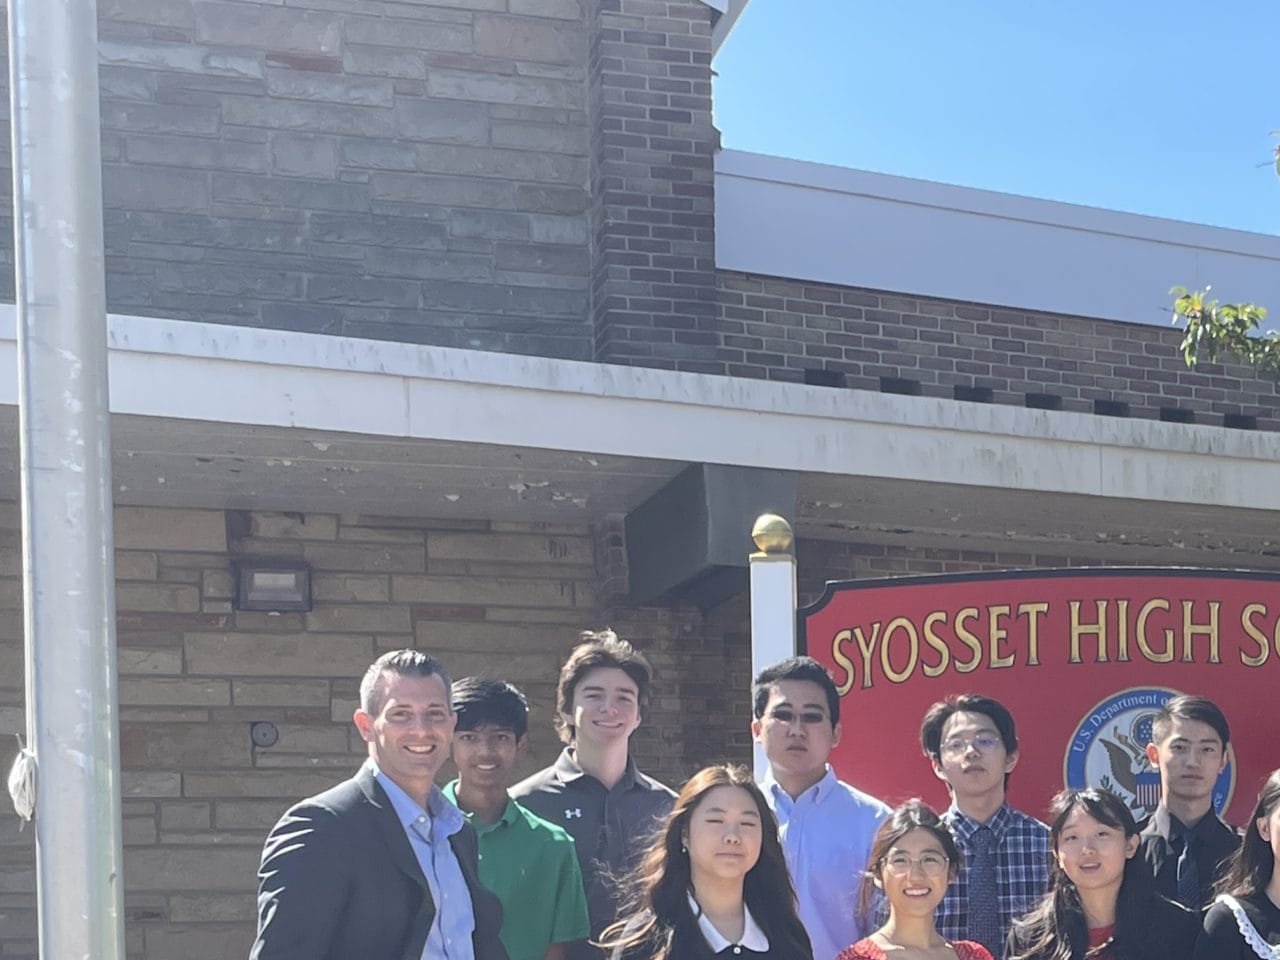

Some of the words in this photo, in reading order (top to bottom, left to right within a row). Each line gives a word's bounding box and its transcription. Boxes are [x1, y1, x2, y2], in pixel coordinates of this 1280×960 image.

[832, 602, 1049, 697] SYOSSET
[1067, 597, 1221, 664] HIGH
[1073, 729, 1094, 752] U.S.
[1090, 694, 1157, 727] Department
